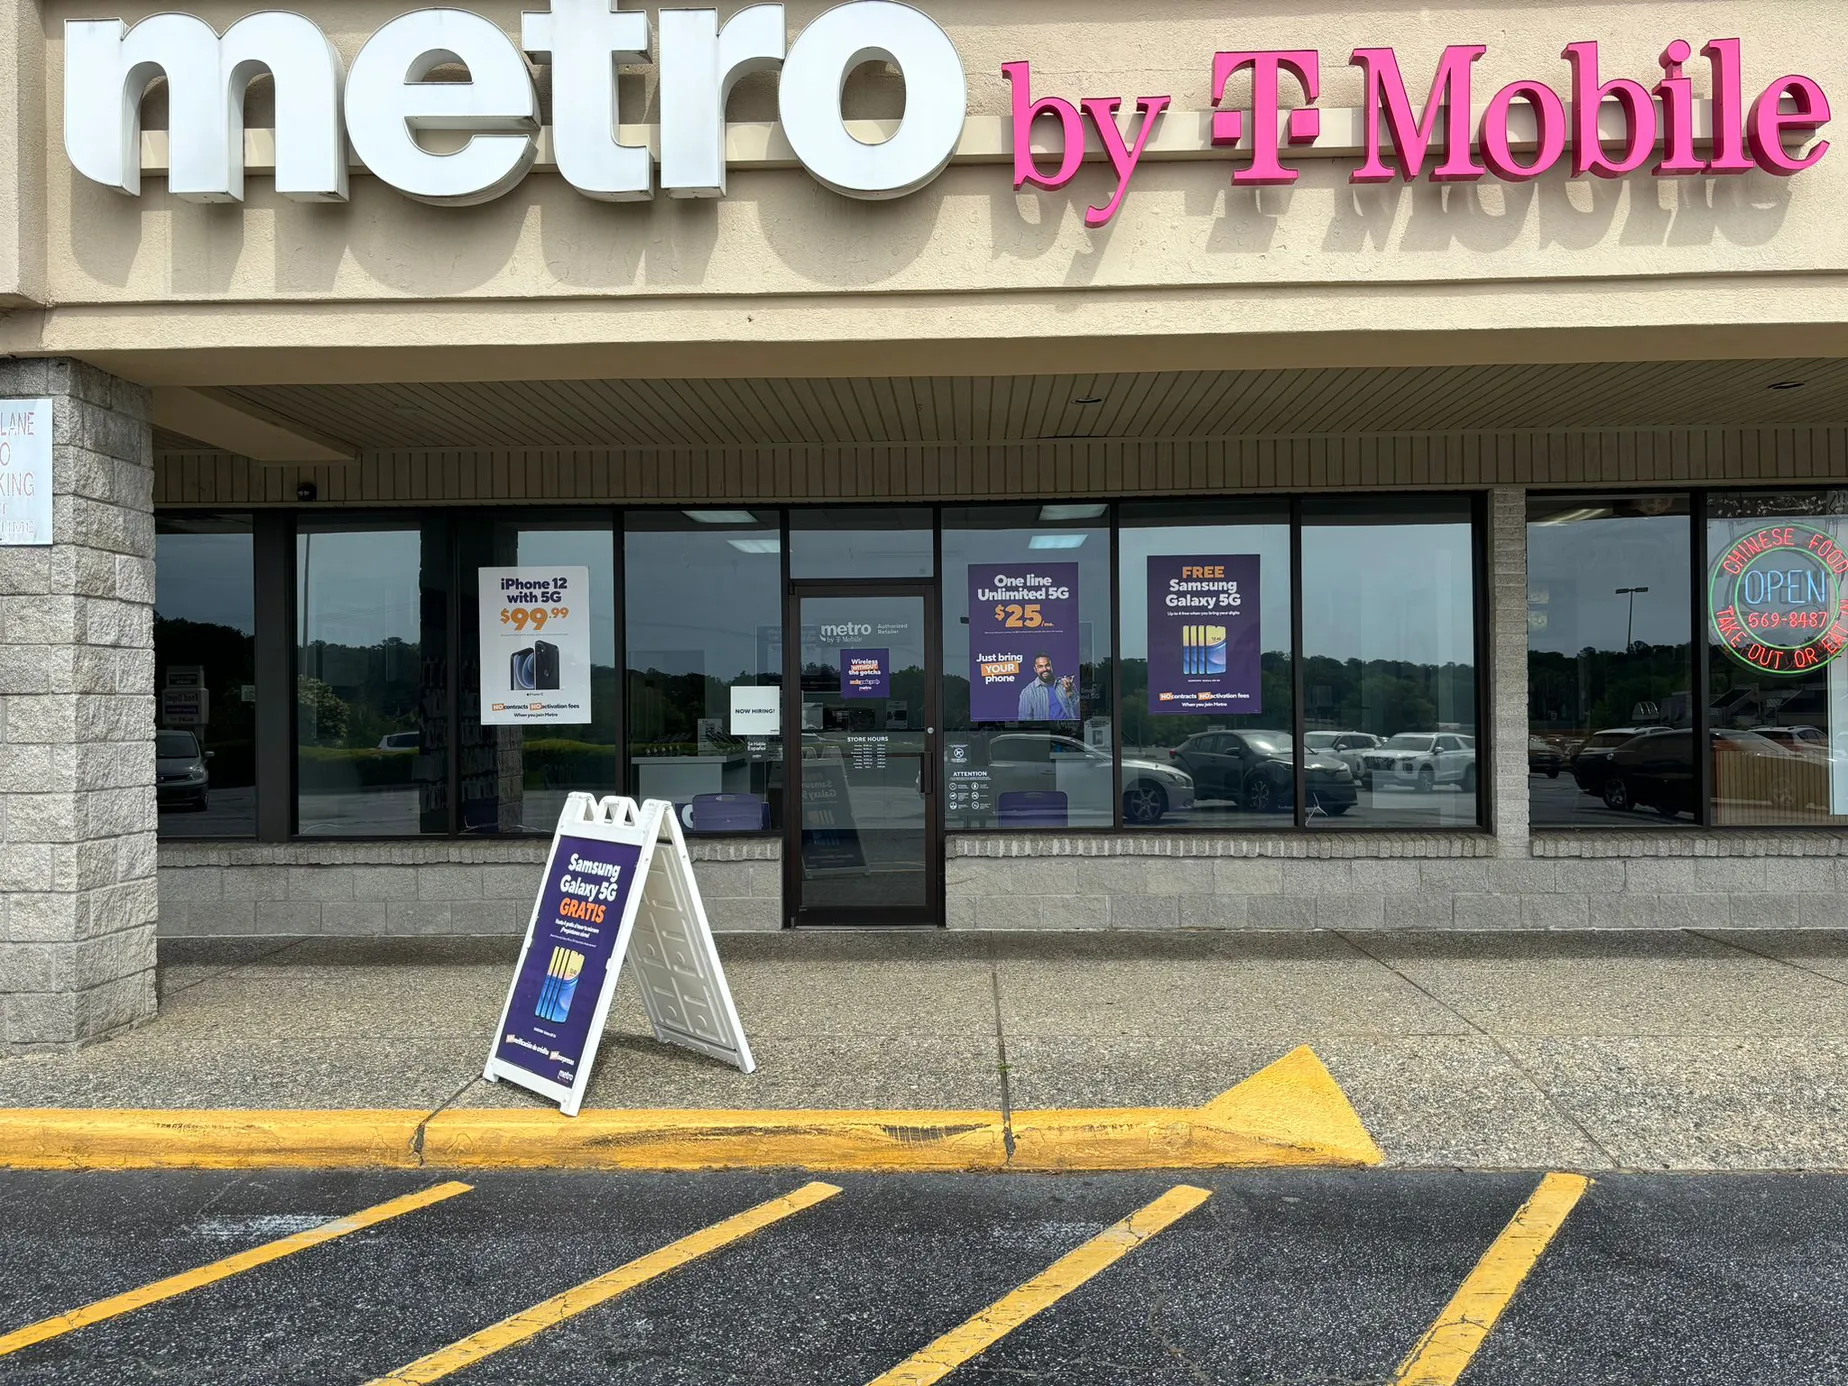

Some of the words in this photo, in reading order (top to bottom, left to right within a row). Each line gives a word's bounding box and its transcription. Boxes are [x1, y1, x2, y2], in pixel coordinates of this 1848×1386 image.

[65, 0, 967, 207] metro
[1000, 61, 1171, 228] by
[1348, 37, 1831, 185] Mobile
[1723, 528, 1794, 575] CHINESE
[1808, 533, 1848, 574] FOOD
[994, 574, 1026, 587] One
[1026, 573, 1052, 586] line
[1182, 566, 1225, 579] FREE
[500, 577, 551, 591] iPhone
[551, 577, 568, 590] 12
[1169, 579, 1237, 593] Samsung
[1745, 569, 1826, 604] OPEN
[506, 591, 538, 604] with
[540, 591, 562, 603] 5G
[977, 588, 1045, 601] Unlimited
[1048, 586, 1069, 600] 5G
[1165, 594, 1217, 609] Galaxy
[1218, 594, 1241, 607] 5G
[1749, 611, 1828, 628] 569-8487
[820, 622, 872, 641] metro
[1717, 605, 1747, 648] TAKE
[1747, 643, 1784, 670] OUT
[1794, 647, 1819, 668] OR
[976, 653, 997, 663] Just
[998, 653, 1023, 664] bring
[985, 663, 1015, 673] YOUR
[985, 674, 1015, 685] phone
[567, 853, 621, 882] Samsung
[559, 874, 600, 902] Galaxy
[598, 881, 619, 902] 5G
[559, 897, 607, 924] GRATIS
